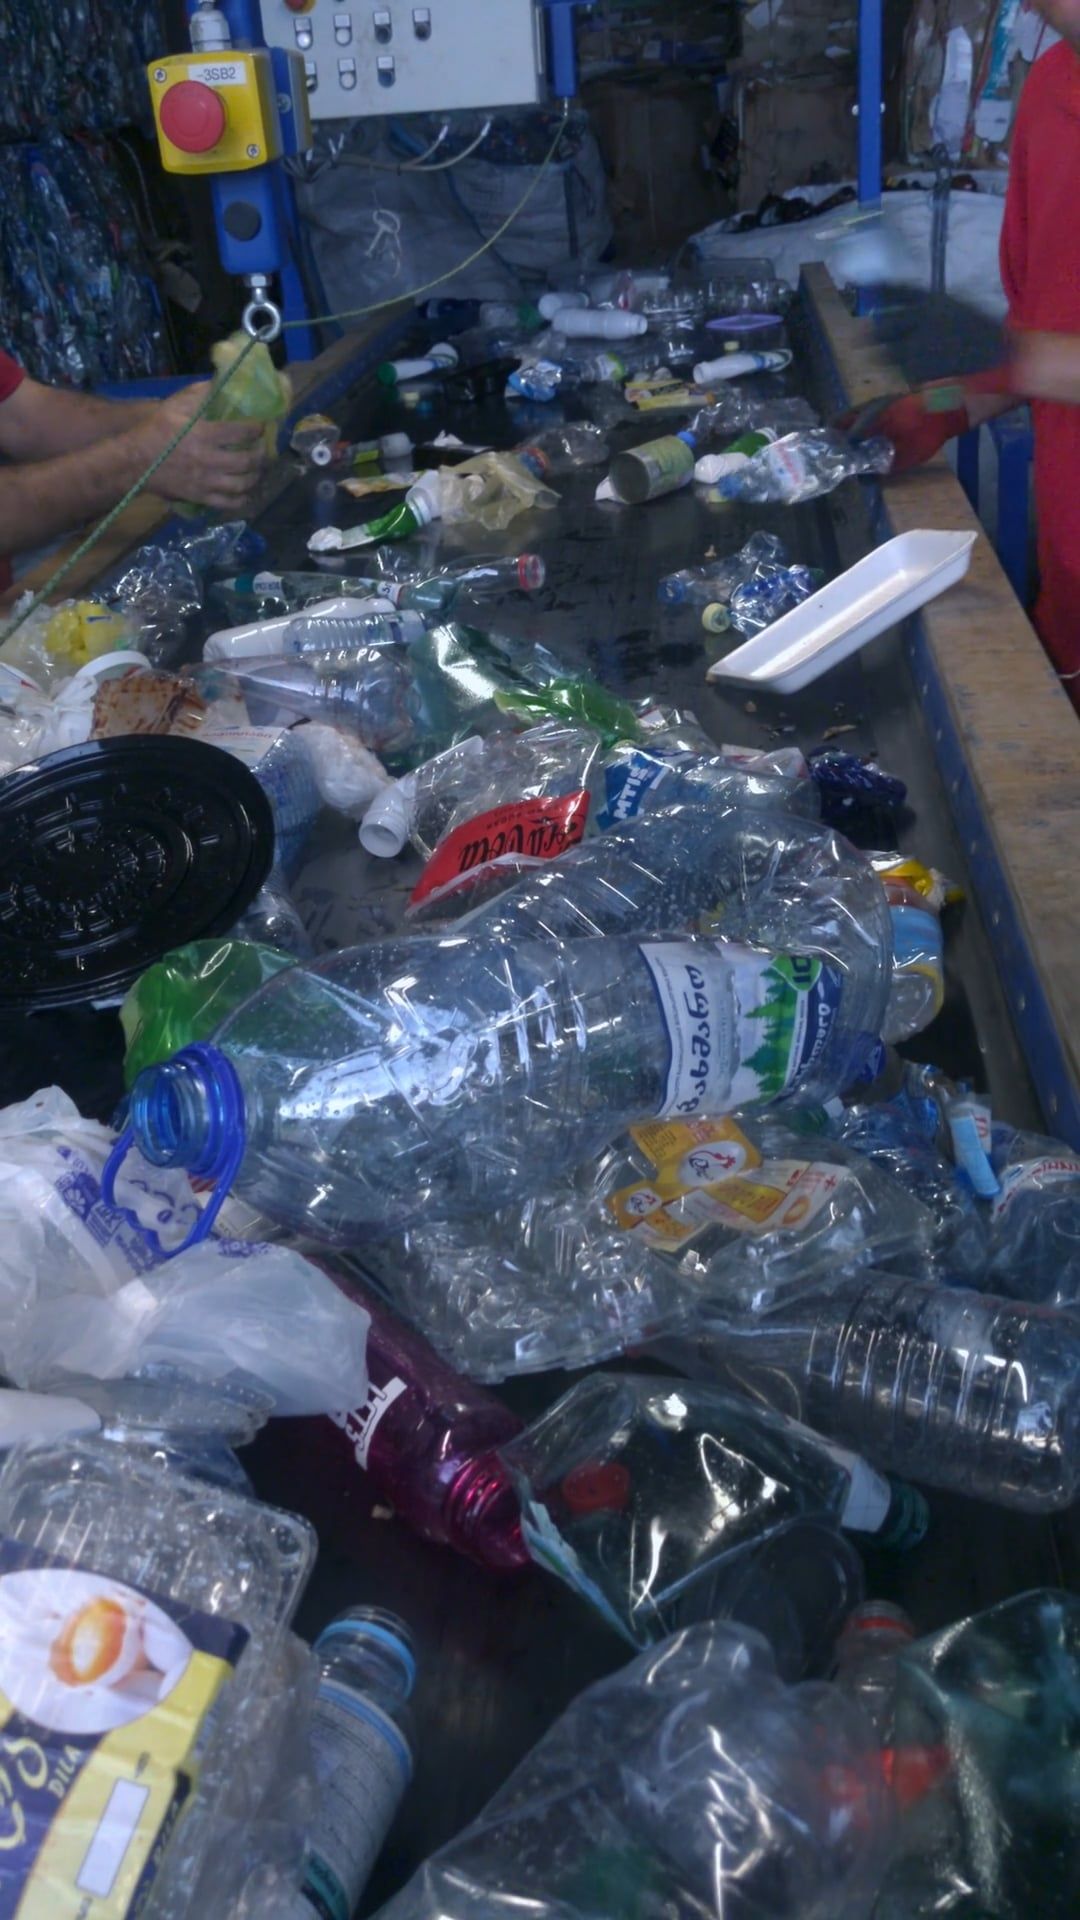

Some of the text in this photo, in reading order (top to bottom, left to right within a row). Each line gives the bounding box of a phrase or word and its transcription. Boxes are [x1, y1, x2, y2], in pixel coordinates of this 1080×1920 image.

[196, 66, 236, 81] -3SB2
[613, 767, 649, 819] MTIS
[676, 965, 711, 1113] ბახმარო
[46, 1744, 83, 1798] DILA
